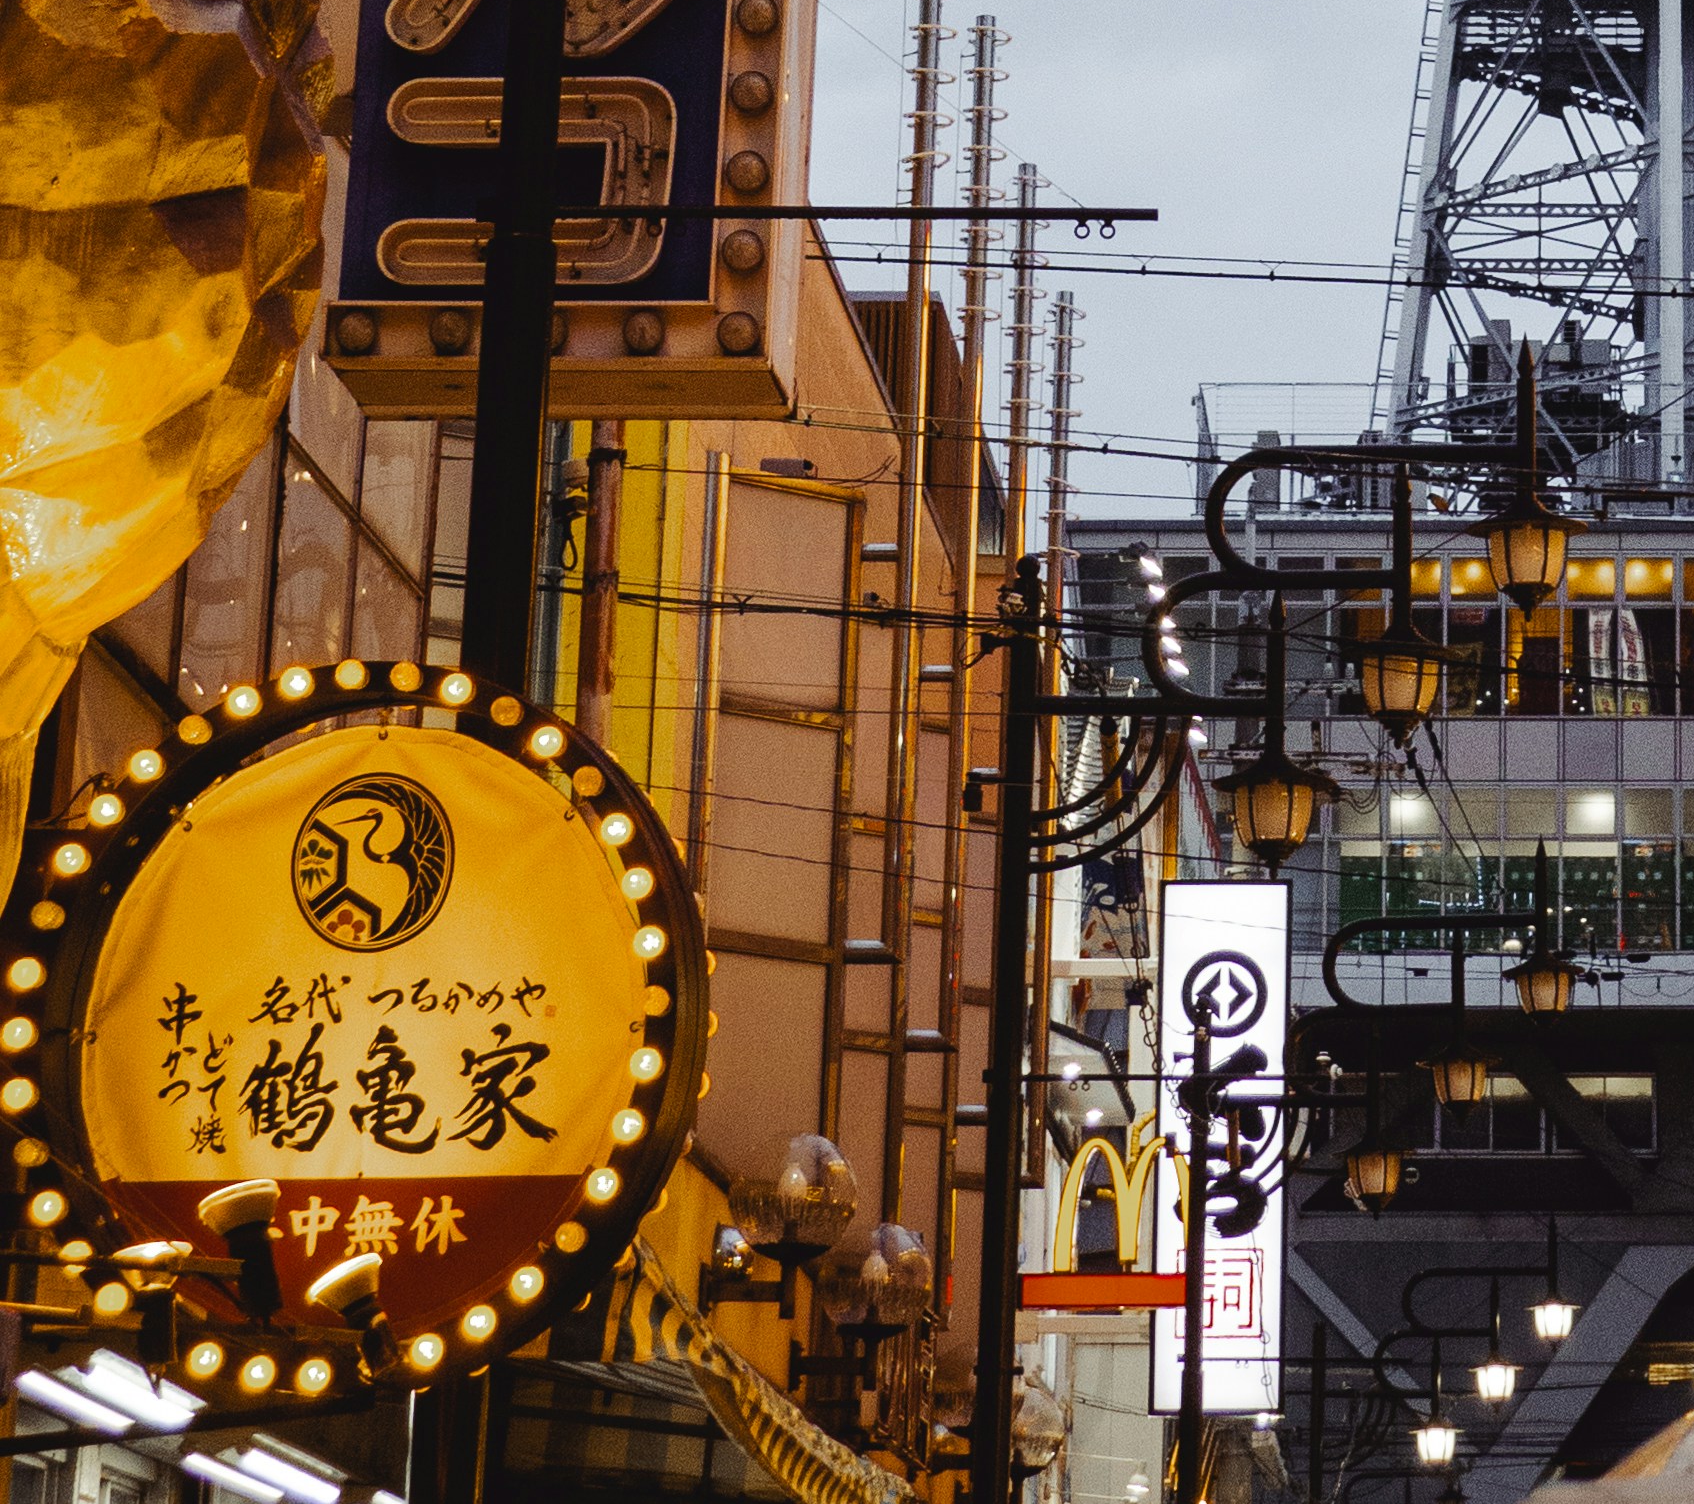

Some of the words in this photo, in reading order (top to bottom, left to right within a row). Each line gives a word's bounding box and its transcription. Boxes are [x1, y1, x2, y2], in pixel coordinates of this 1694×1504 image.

[157, 982, 205, 1106] 串かつ
[249, 974, 351, 1026] 名代
[366, 977, 547, 1020] つるかめや
[238, 1023, 559, 1155] 鶴亀家
[270, 1194, 467, 1257] 中無休
